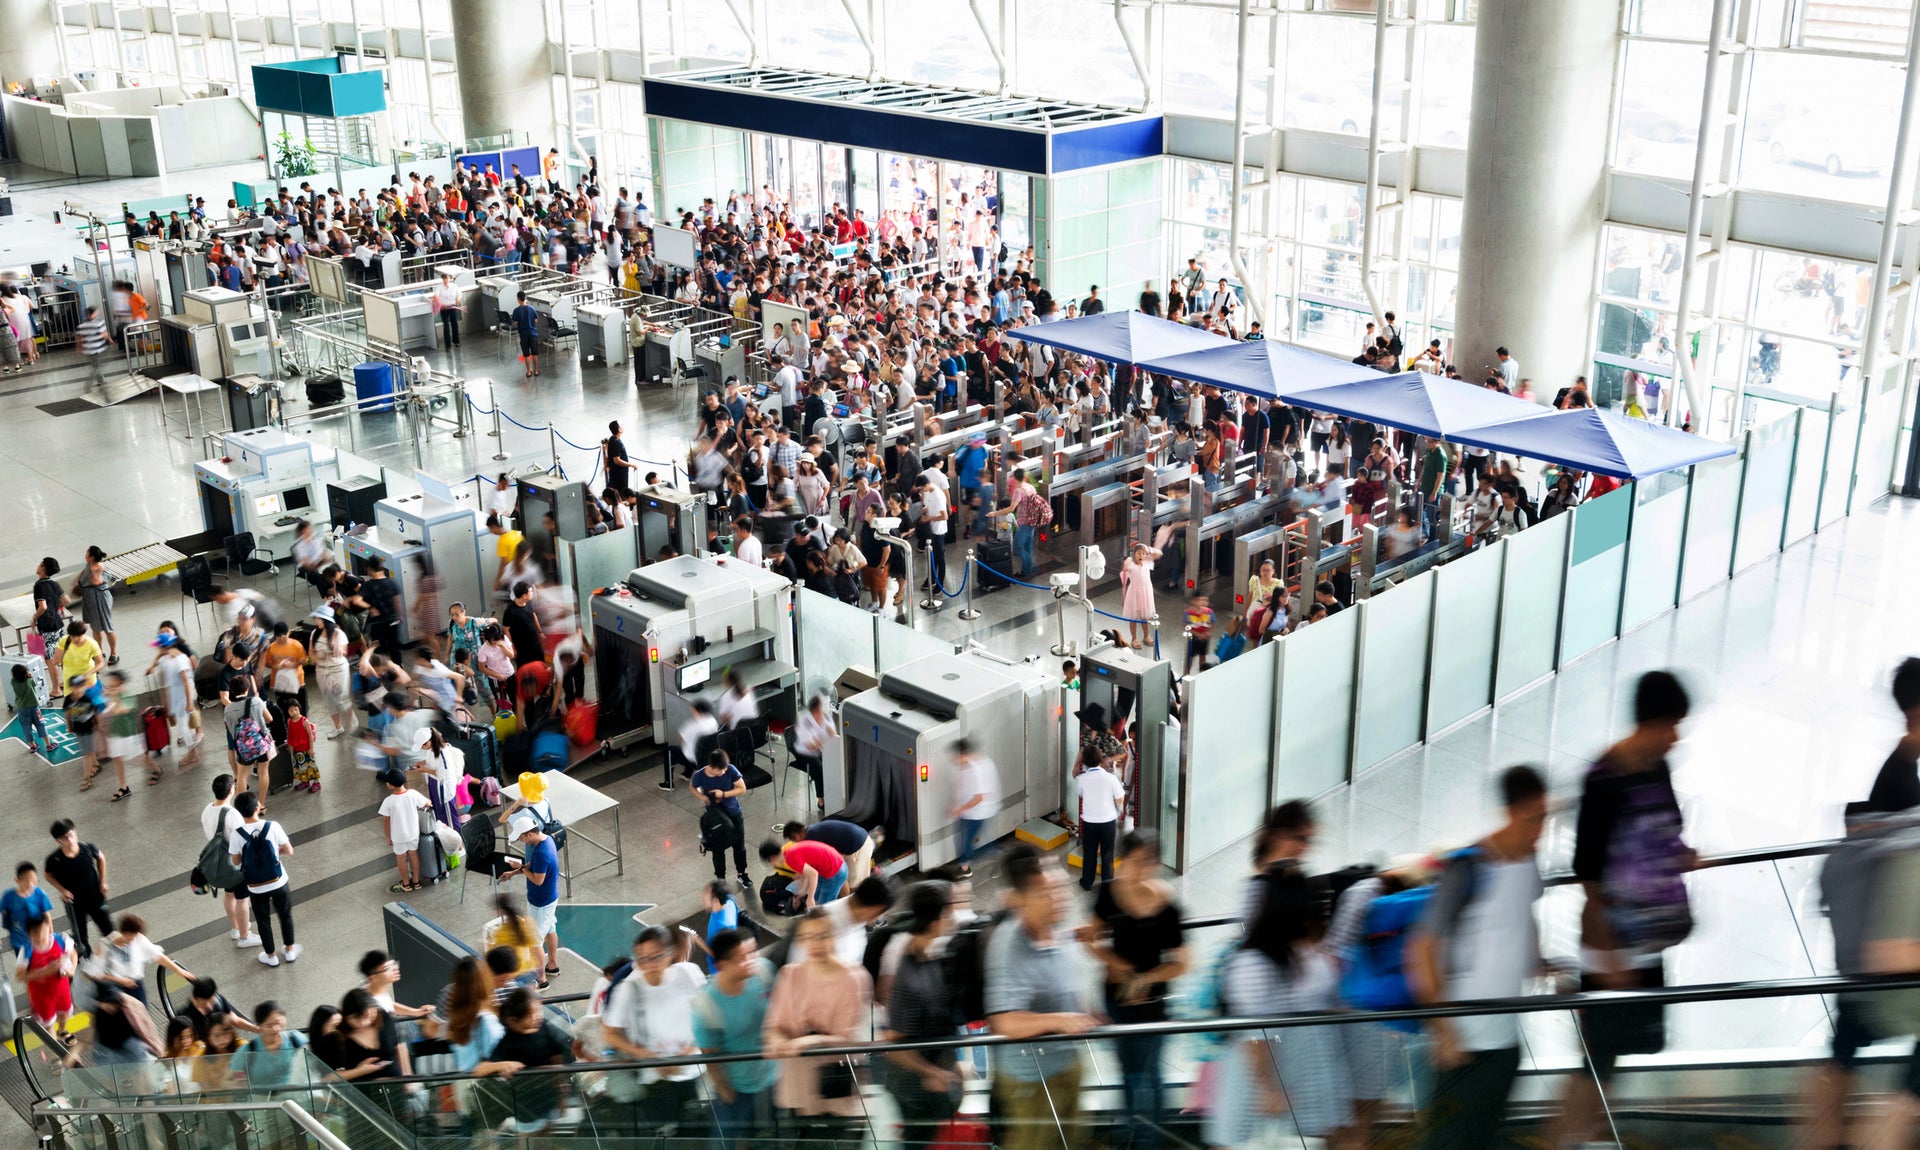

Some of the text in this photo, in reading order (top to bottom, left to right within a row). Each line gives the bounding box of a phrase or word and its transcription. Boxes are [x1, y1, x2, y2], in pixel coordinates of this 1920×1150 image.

[397, 518, 405, 533] 3
[616, 615, 625, 633] 2
[872, 725, 879, 743] 1
